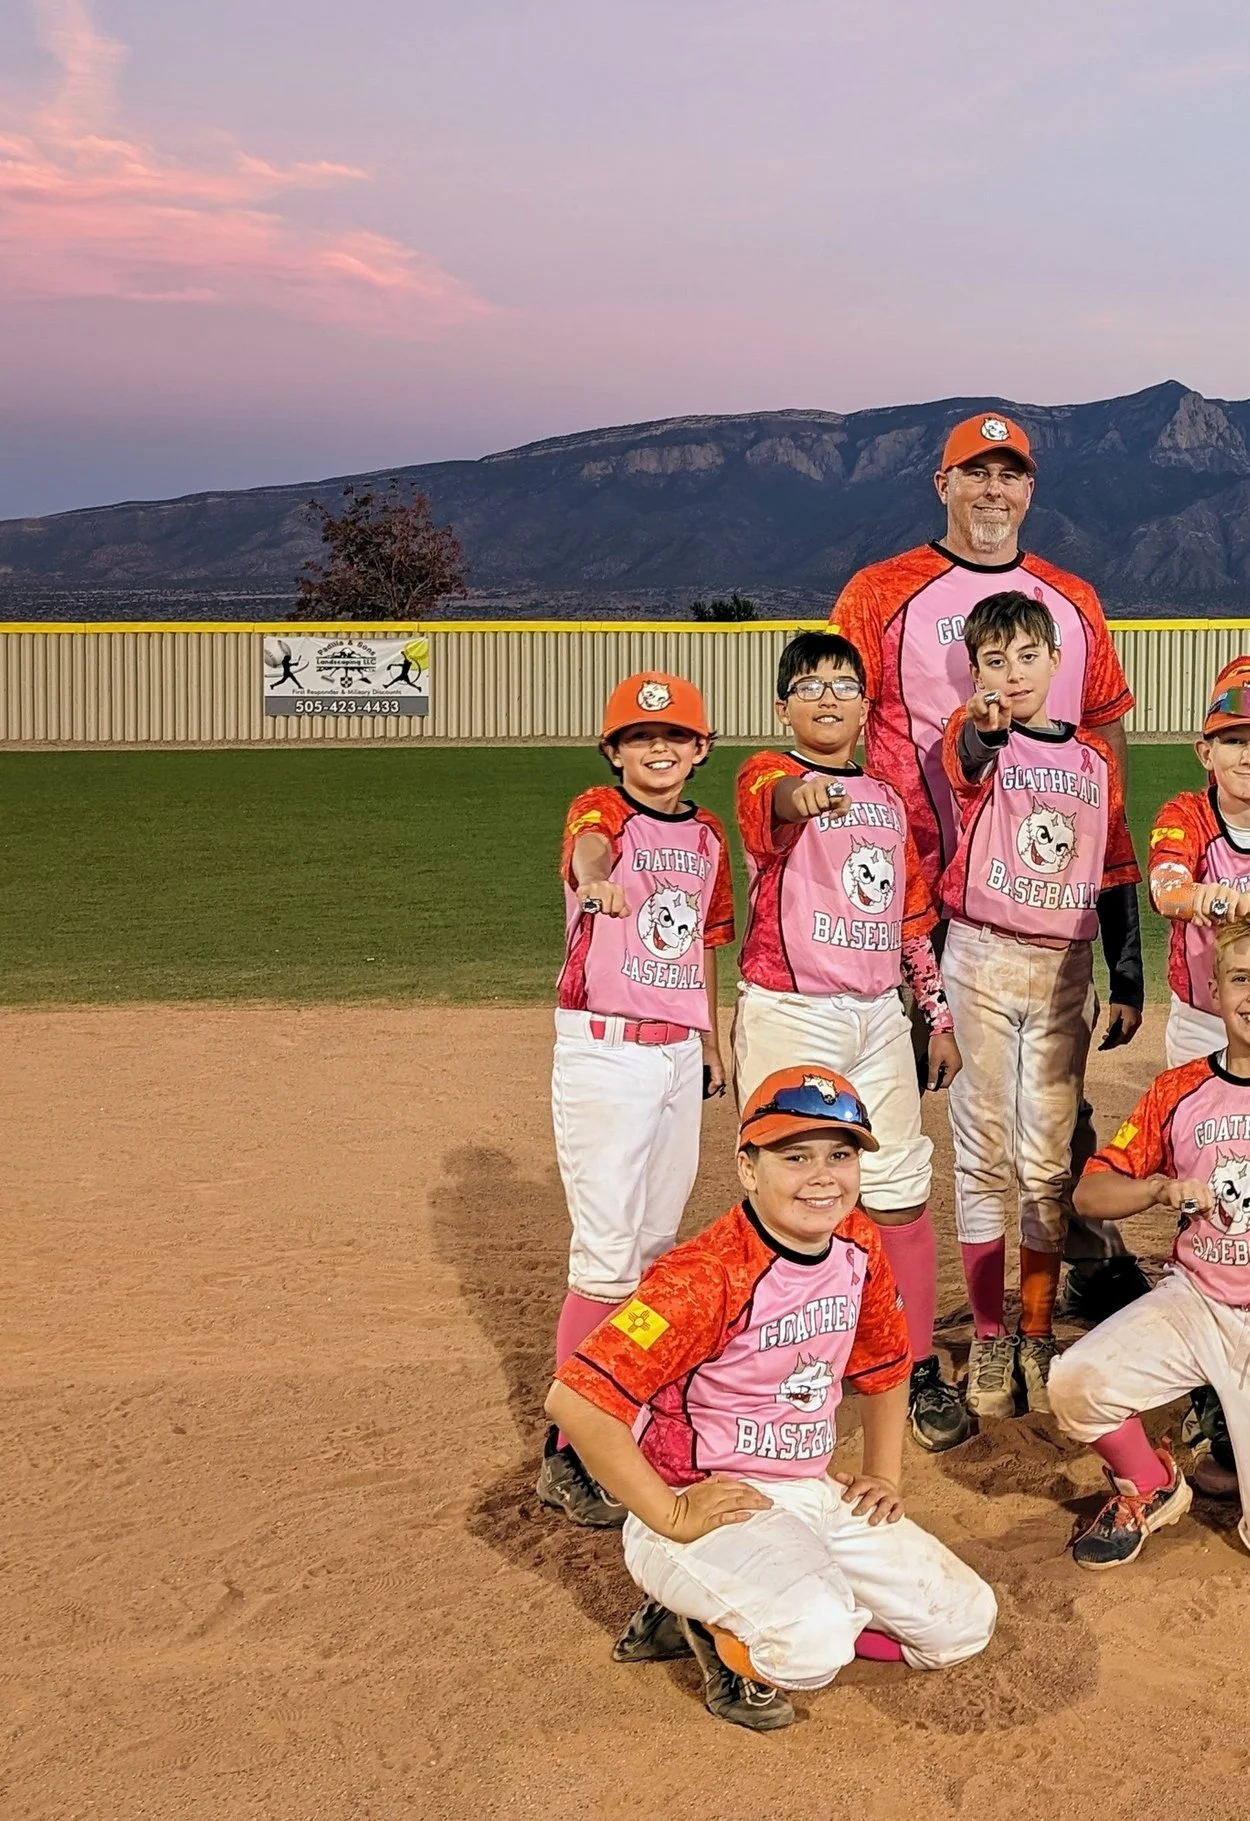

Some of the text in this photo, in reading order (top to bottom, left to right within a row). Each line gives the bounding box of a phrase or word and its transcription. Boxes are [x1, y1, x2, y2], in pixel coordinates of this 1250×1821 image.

[316, 658, 377, 667] Landscaping LLC
[295, 700, 400, 714] 505-423-4433
